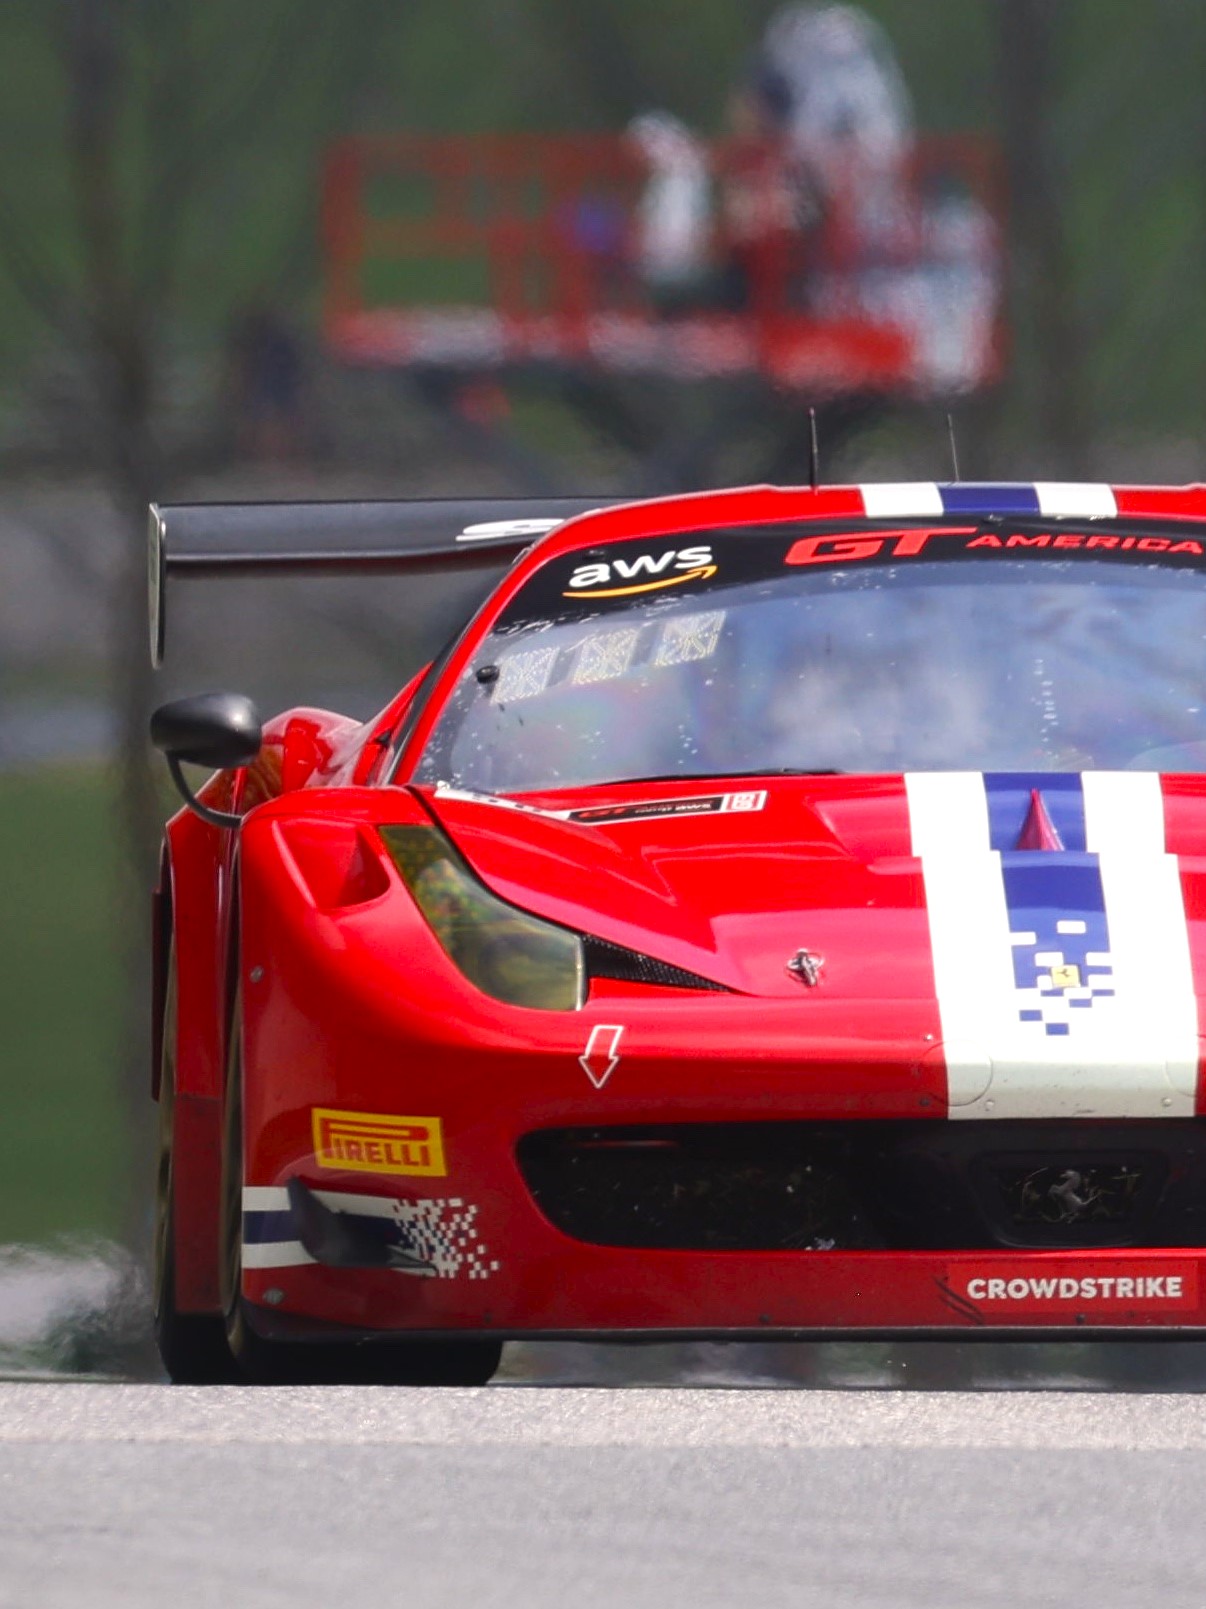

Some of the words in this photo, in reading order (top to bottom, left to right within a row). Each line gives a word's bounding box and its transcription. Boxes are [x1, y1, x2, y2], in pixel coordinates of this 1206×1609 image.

[569, 545, 713, 588] aws
[785, 526, 978, 566] GT
[966, 534, 1204, 555] AMERICA
[320, 1118, 430, 1167] PIRELLI
[966, 1276, 1183, 1300] CROWDSTRIKE
